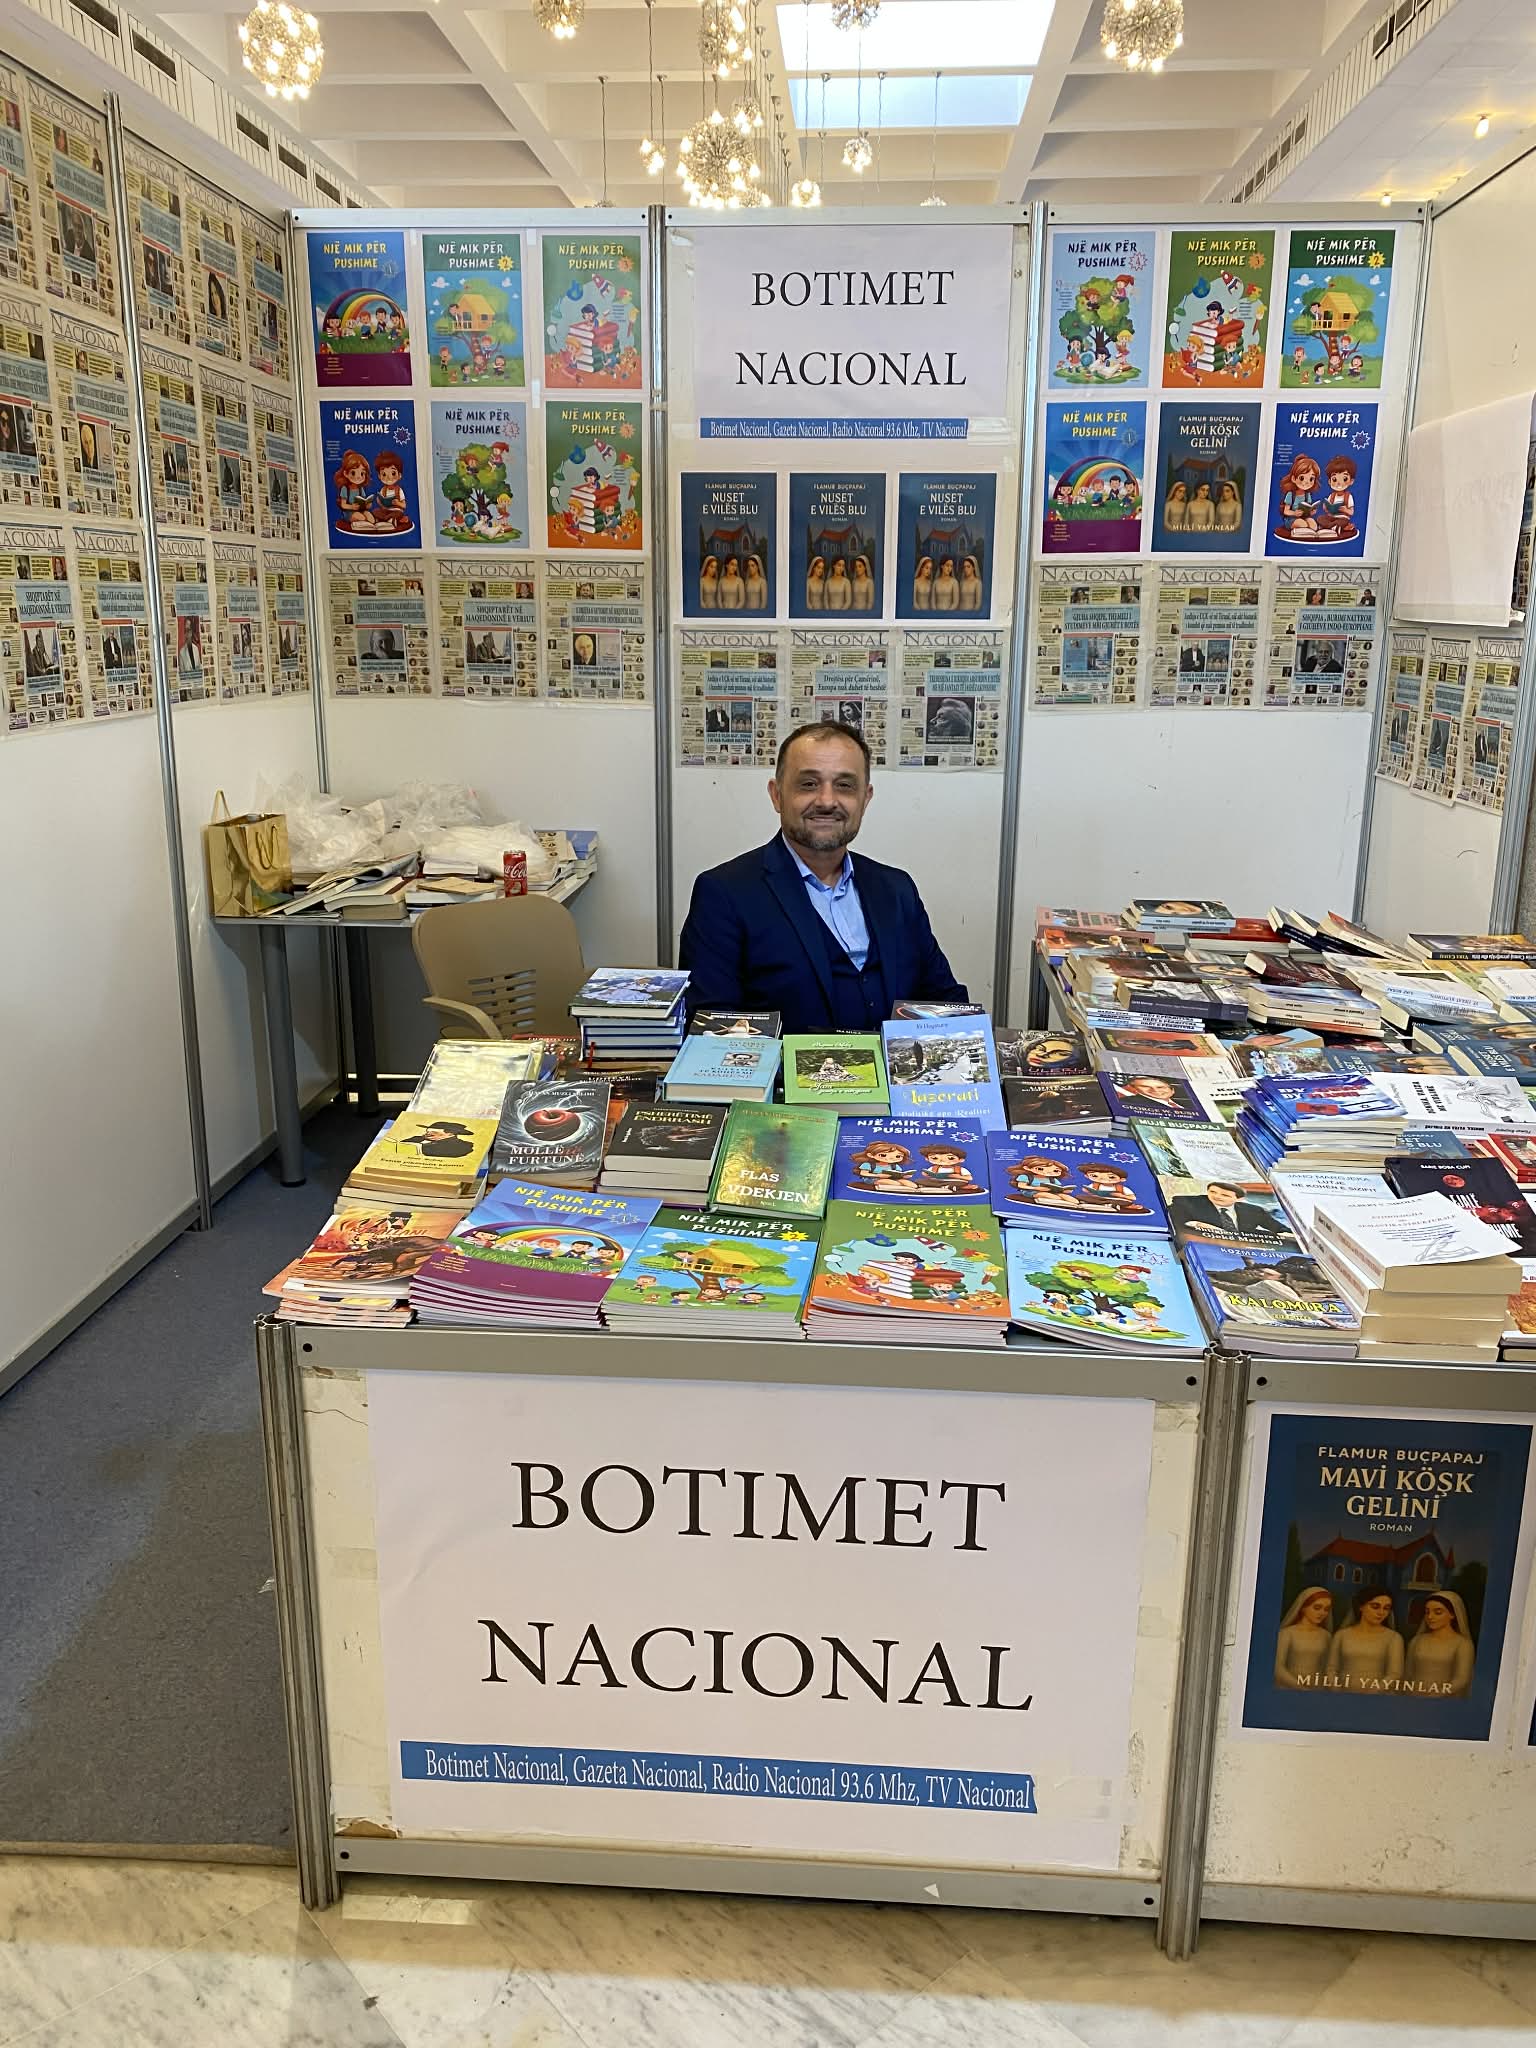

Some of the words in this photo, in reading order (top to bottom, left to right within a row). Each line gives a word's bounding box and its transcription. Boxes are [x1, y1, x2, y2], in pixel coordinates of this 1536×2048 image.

[323, 241, 340, 254] NJË
[344, 244, 362, 254] MIK
[366, 241, 386, 254] PËR
[438, 242, 456, 254] NJË
[460, 244, 479, 254] MIK
[483, 241, 504, 254] PËR
[559, 242, 576, 255] NJË
[580, 245, 600, 255] MIK
[603, 242, 624, 255] PËR
[1068, 240, 1086, 253] NJË
[1090, 242, 1110, 252] MIK
[1116, 240, 1137, 252] PËR
[1188, 238, 1206, 250] NJË
[1210, 240, 1230, 250] MIK
[1234, 238, 1256, 250] PËR
[1306, 238, 1326, 250] NJË
[1329, 240, 1350, 250] MIK
[1354, 238, 1376, 250] PËR
[334, 258, 378, 269] PUSHIME
[450, 258, 494, 268] PUSHIME
[568, 259, 614, 270] PUSHIME
[1078, 257, 1126, 268] PUSHIME
[1197, 256, 1246, 266] PUSHIME
[1316, 255, 1365, 266] PUSHIME
[751, 270, 954, 306] BOTIMET
[735, 351, 966, 386] NACIONAL
[334, 408, 351, 420] NJË
[355, 410, 374, 420] MIK
[378, 408, 398, 420] PËR
[446, 408, 462, 420] NJË
[466, 410, 487, 420] MIK
[490, 408, 510, 421] PËR
[562, 408, 578, 420] NJË
[582, 410, 601, 420] MIK
[606, 408, 624, 421] PËR
[1063, 410, 1080, 422] NJË
[1084, 412, 1103, 422] MIK
[1107, 410, 1128, 422] PËR
[1290, 410, 1310, 423] NJË
[1312, 413, 1334, 423] MIK
[1338, 410, 1360, 424] PËR
[344, 424, 390, 434] PUSHIME
[456, 424, 500, 434] PUSHIME
[572, 424, 616, 434] PUSHIME
[710, 421, 738, 436] Botimet
[740, 421, 772, 438] Nacional,
[773, 422, 797, 436] Gazeta
[798, 421, 830, 438] Nacional,
[832, 422, 853, 436] Radio
[854, 422, 884, 436] Nacional
[886, 422, 900, 436] 93.6
[902, 422, 920, 438] Mhz,
[922, 422, 934, 436] TV
[936, 422, 966, 437] Nacional
[1072, 427, 1117, 437] PUSHIME
[1209, 424, 1240, 437] KÖŞK
[1300, 428, 1348, 438] PUSHIME
[712, 492, 744, 502] NUSET
[820, 493, 854, 503] NUSET
[930, 493, 964, 503] NUSET
[702, 505, 708, 514] E
[710, 504, 736, 514] VILËS
[740, 505, 758, 514] BLU
[810, 505, 816, 514] E
[819, 504, 845, 515] VILËS
[848, 505, 866, 514] BLU
[920, 505, 926, 514] E
[928, 504, 955, 514] VILËS
[958, 505, 976, 515] BLU
[75, 528, 136, 552] NACIONAL
[328, 560, 424, 574] NACIONAL
[439, 562, 534, 577] NACIONAL
[546, 562, 644, 578] NACIONAL
[1041, 566, 1142, 582] NACIONAL
[1160, 568, 1261, 583] NACIONAL
[1276, 568, 1380, 583] NACIONAL
[681, 631, 778, 646] NACIONAL
[792, 632, 888, 646] NACIONAL
[905, 632, 1003, 646] NACIONAL
[1122, 1104, 1160, 1112] GEORGE
[857, 1118, 888, 1128] NJË
[890, 1120, 920, 1128] MIK
[926, 1119, 959, 1130] PËR
[872, 1126, 944, 1136] PUSHIME
[1010, 1132, 1037, 1142] NJË
[1040, 1136, 1076, 1146] MIK
[1082, 1138, 1116, 1150] PËR
[510, 1144, 564, 1155] MOLLË
[1026, 1141, 1102, 1155] PUSHIME
[508, 1152, 585, 1165] FURTUNË
[740, 1170, 780, 1182] PLAS
[514, 1186, 547, 1198] NJË
[552, 1194, 586, 1204] MIK
[592, 1198, 628, 1210] PËR
[728, 1184, 809, 1204] VDEKJEN
[524, 1198, 606, 1216] PUSHIME
[678, 1213, 714, 1224] NJË
[719, 1218, 750, 1228] MIK
[756, 1220, 794, 1232] PËR
[856, 1208, 886, 1220] NJË
[893, 1215, 924, 1226] MIK
[932, 1216, 973, 1230] PËR
[692, 1224, 774, 1239] PUSHIME
[872, 1220, 954, 1238] PUSHIME
[1033, 1234, 1062, 1244] NJË
[1070, 1240, 1105, 1250] MIK
[1112, 1242, 1148, 1253] PËR
[1238, 1236, 1284, 1246] Marinaj
[1050, 1244, 1132, 1262] PUSHIME
[1220, 1248, 1258, 1257] KOZMA
[1228, 1294, 1343, 1314] KALOMIRA
[1318, 1446, 1388, 1460] FLAMUR
[1396, 1450, 1484, 1465] BUÇPAPAJ
[1320, 1464, 1387, 1490] MAVİ
[1396, 1466, 1474, 1496] KÖŞK
[510, 1462, 1006, 1551] BOTIMET
[1346, 1493, 1441, 1519] GELİNİ
[1370, 1523, 1413, 1532] ROMAN
[477, 1619, 1034, 1712] NACIONAL
[1296, 1673, 1350, 1689] MİLLİ
[1359, 1676, 1454, 1694] YAYINLAR
[425, 1748, 490, 1778] Botimet
[493, 1752, 568, 1785] Nacional,
[573, 1755, 628, 1784] Gazeta
[632, 1758, 708, 1792] Nacional,
[712, 1762, 759, 1793] Radio
[764, 1766, 836, 1798] Nacional
[840, 1771, 874, 1799] 93.6
[879, 1772, 920, 1806] Mhz,
[926, 1776, 953, 1804] TV
[956, 1778, 1030, 1808] Nacional
